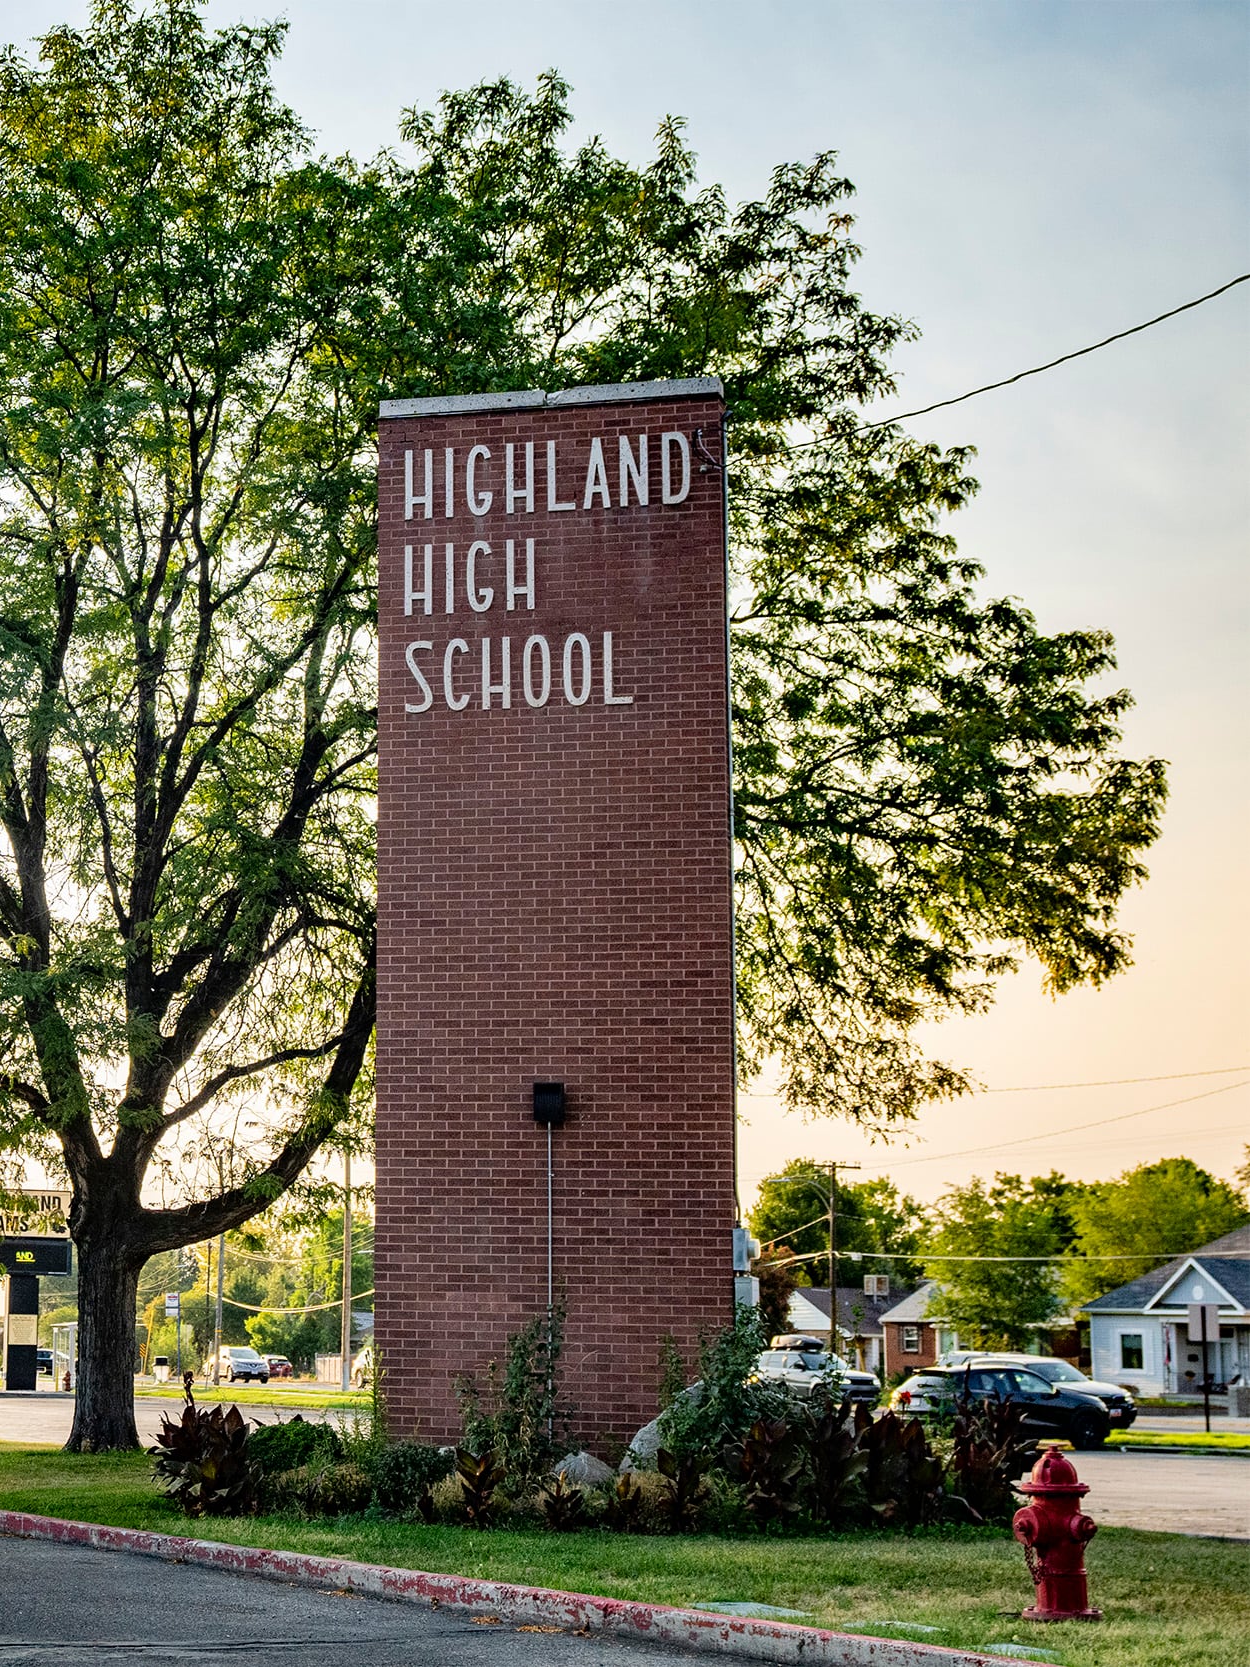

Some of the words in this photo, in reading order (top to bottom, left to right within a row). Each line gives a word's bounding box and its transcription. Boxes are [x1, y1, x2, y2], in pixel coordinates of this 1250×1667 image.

[404, 431, 691, 520] HIGHLAND
[404, 537, 536, 616] HIGH
[404, 631, 634, 713] SCHOOL
